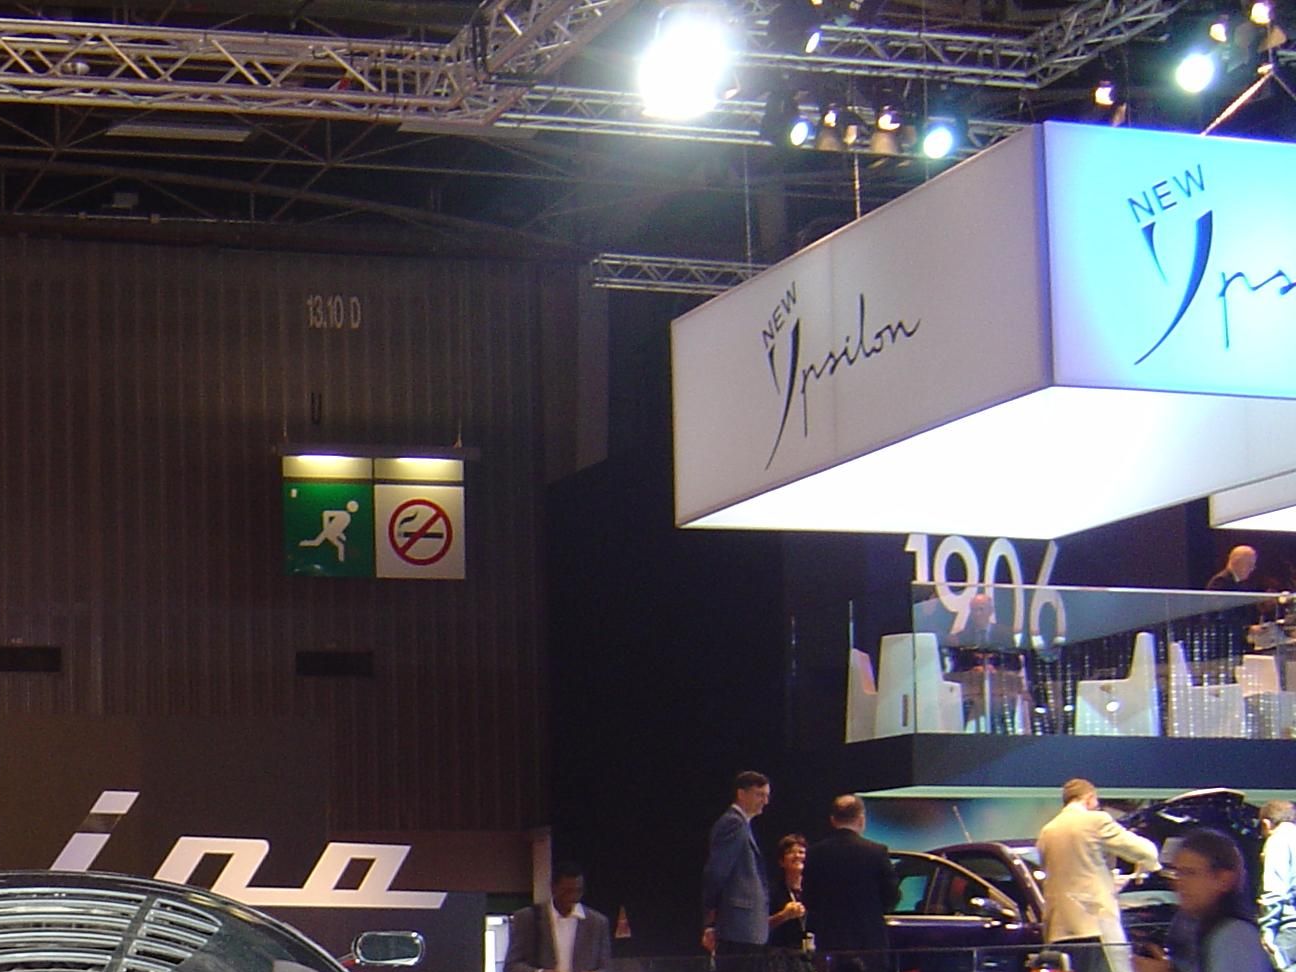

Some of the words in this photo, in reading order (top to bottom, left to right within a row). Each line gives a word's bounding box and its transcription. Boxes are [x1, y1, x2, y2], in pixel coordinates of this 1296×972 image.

[1127, 164, 1205, 223] NEW
[762, 280, 797, 348] NEW
[765, 293, 921, 470] Ypsilon
[904, 533, 1067, 660] 1906
